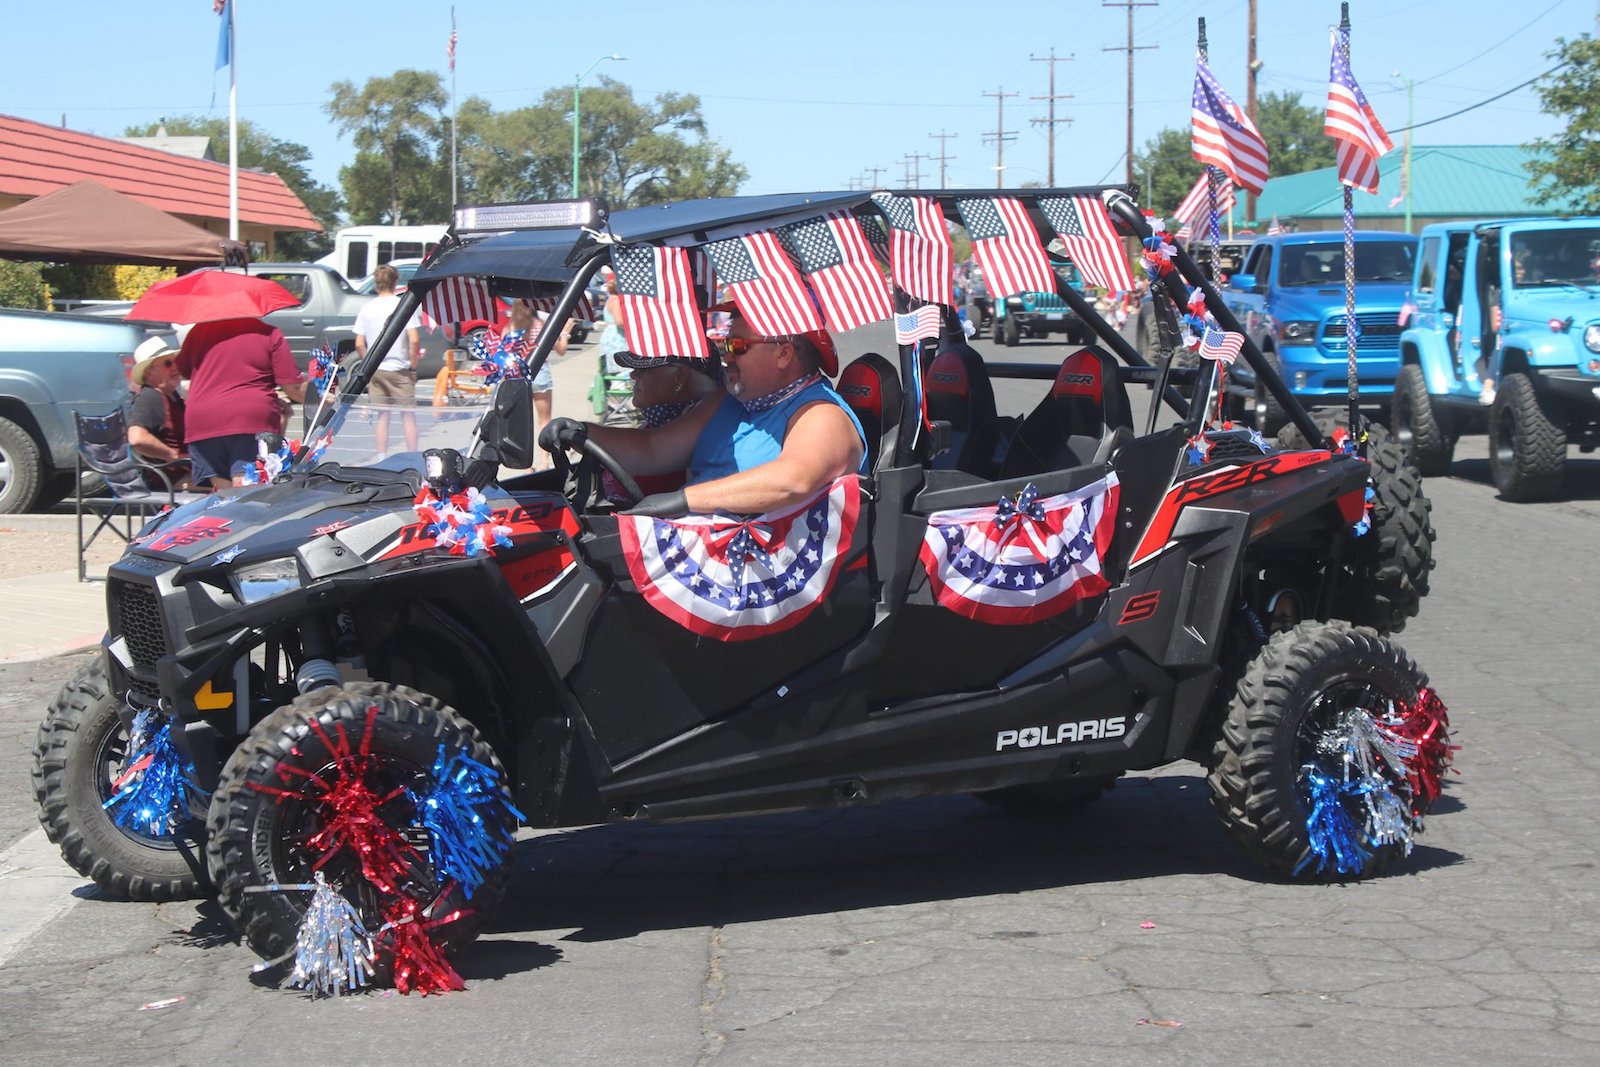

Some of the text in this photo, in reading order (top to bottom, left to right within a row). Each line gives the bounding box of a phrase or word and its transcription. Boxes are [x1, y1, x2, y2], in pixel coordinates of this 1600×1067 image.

[842, 383, 872, 398] RZR
[932, 373, 960, 385] RZR
[1063, 374, 1094, 386] RZR
[1173, 457, 1282, 505] RZR
[1117, 590, 1161, 625] S
[996, 716, 1126, 752] POLARIS
